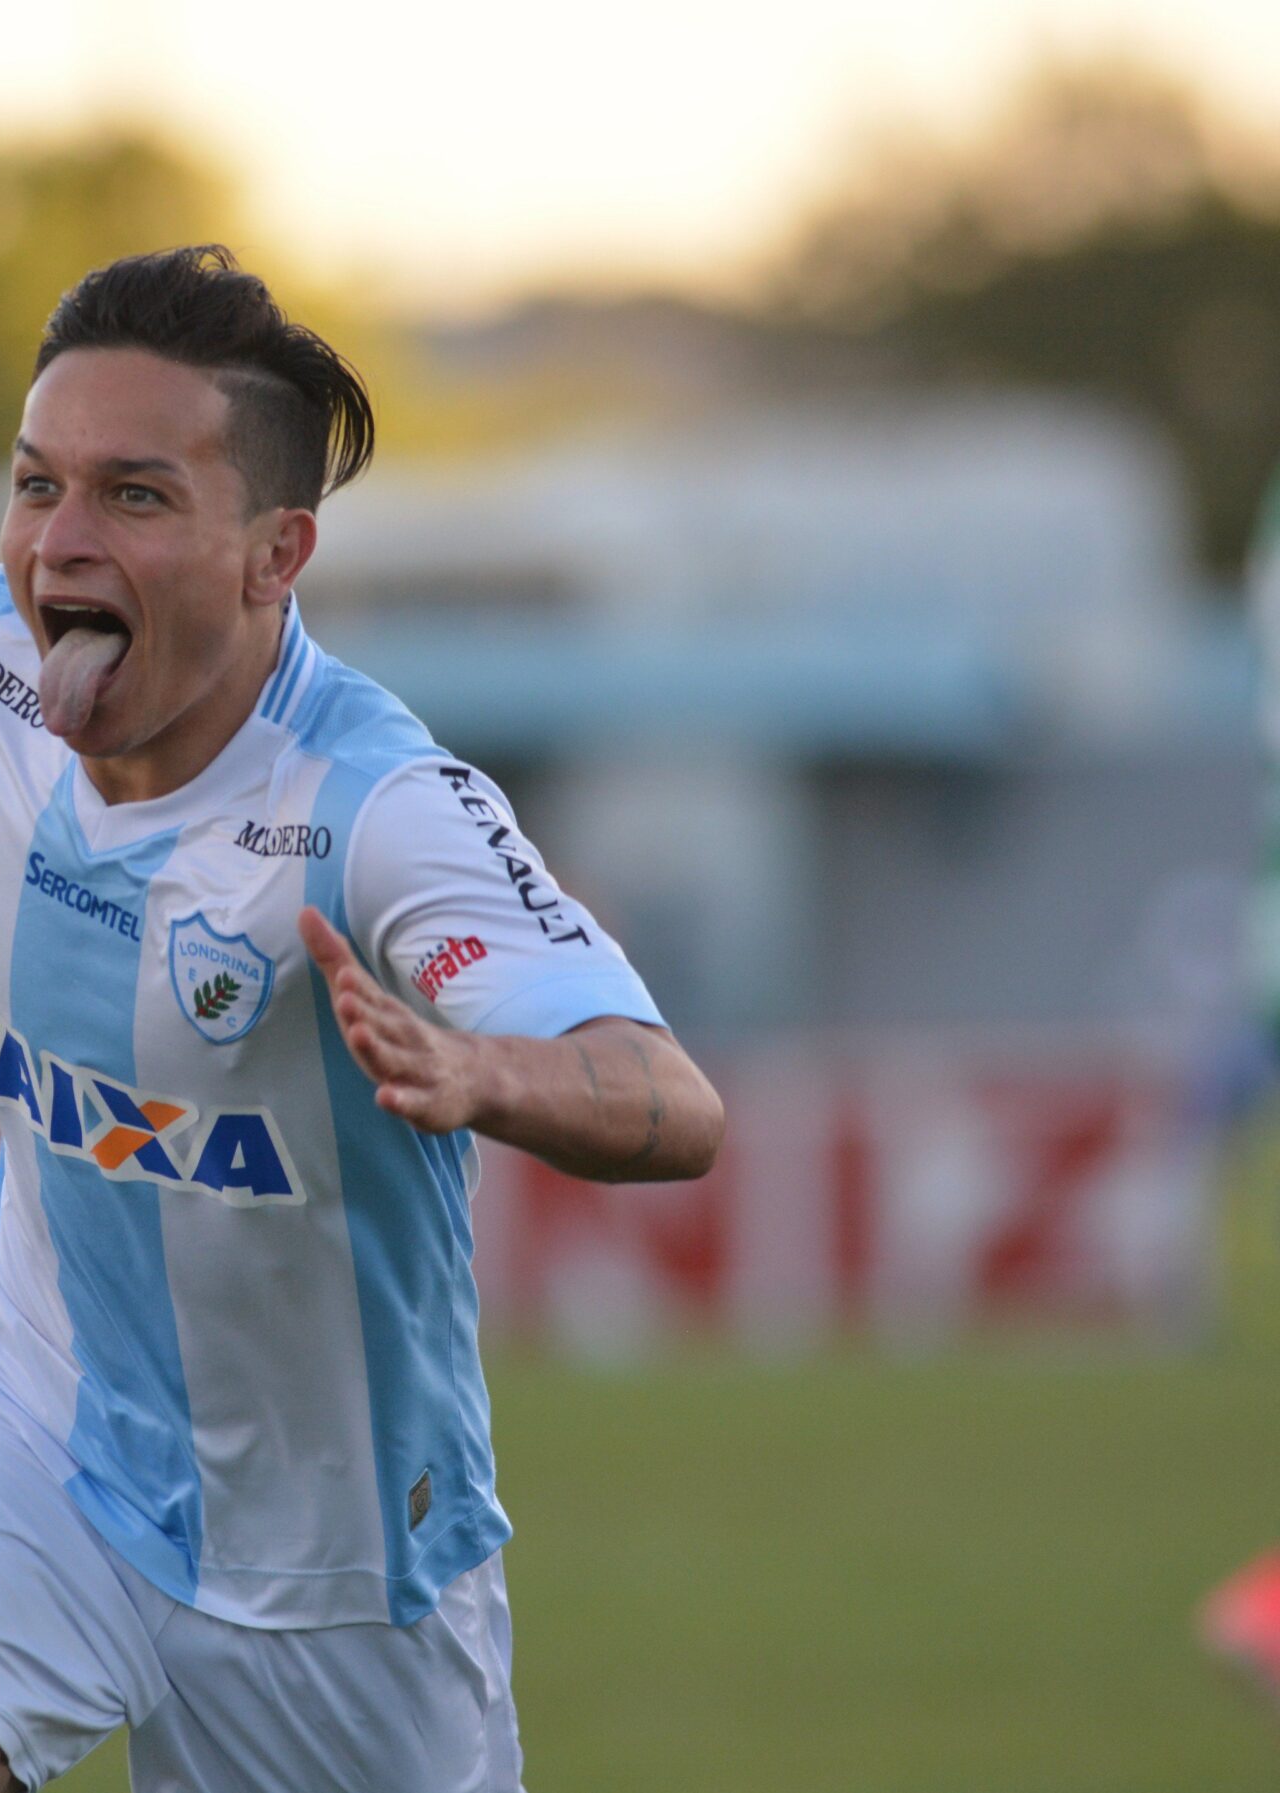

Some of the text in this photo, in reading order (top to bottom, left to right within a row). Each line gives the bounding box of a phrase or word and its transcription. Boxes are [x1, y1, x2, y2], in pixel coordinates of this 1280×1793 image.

[25, 851, 141, 942] SERCOMTEL
[178, 941, 261, 982] LONDRINA
[188, 967, 197, 982] E
[415, 934, 488, 1005] uffato
[227, 1016, 237, 1028] C
